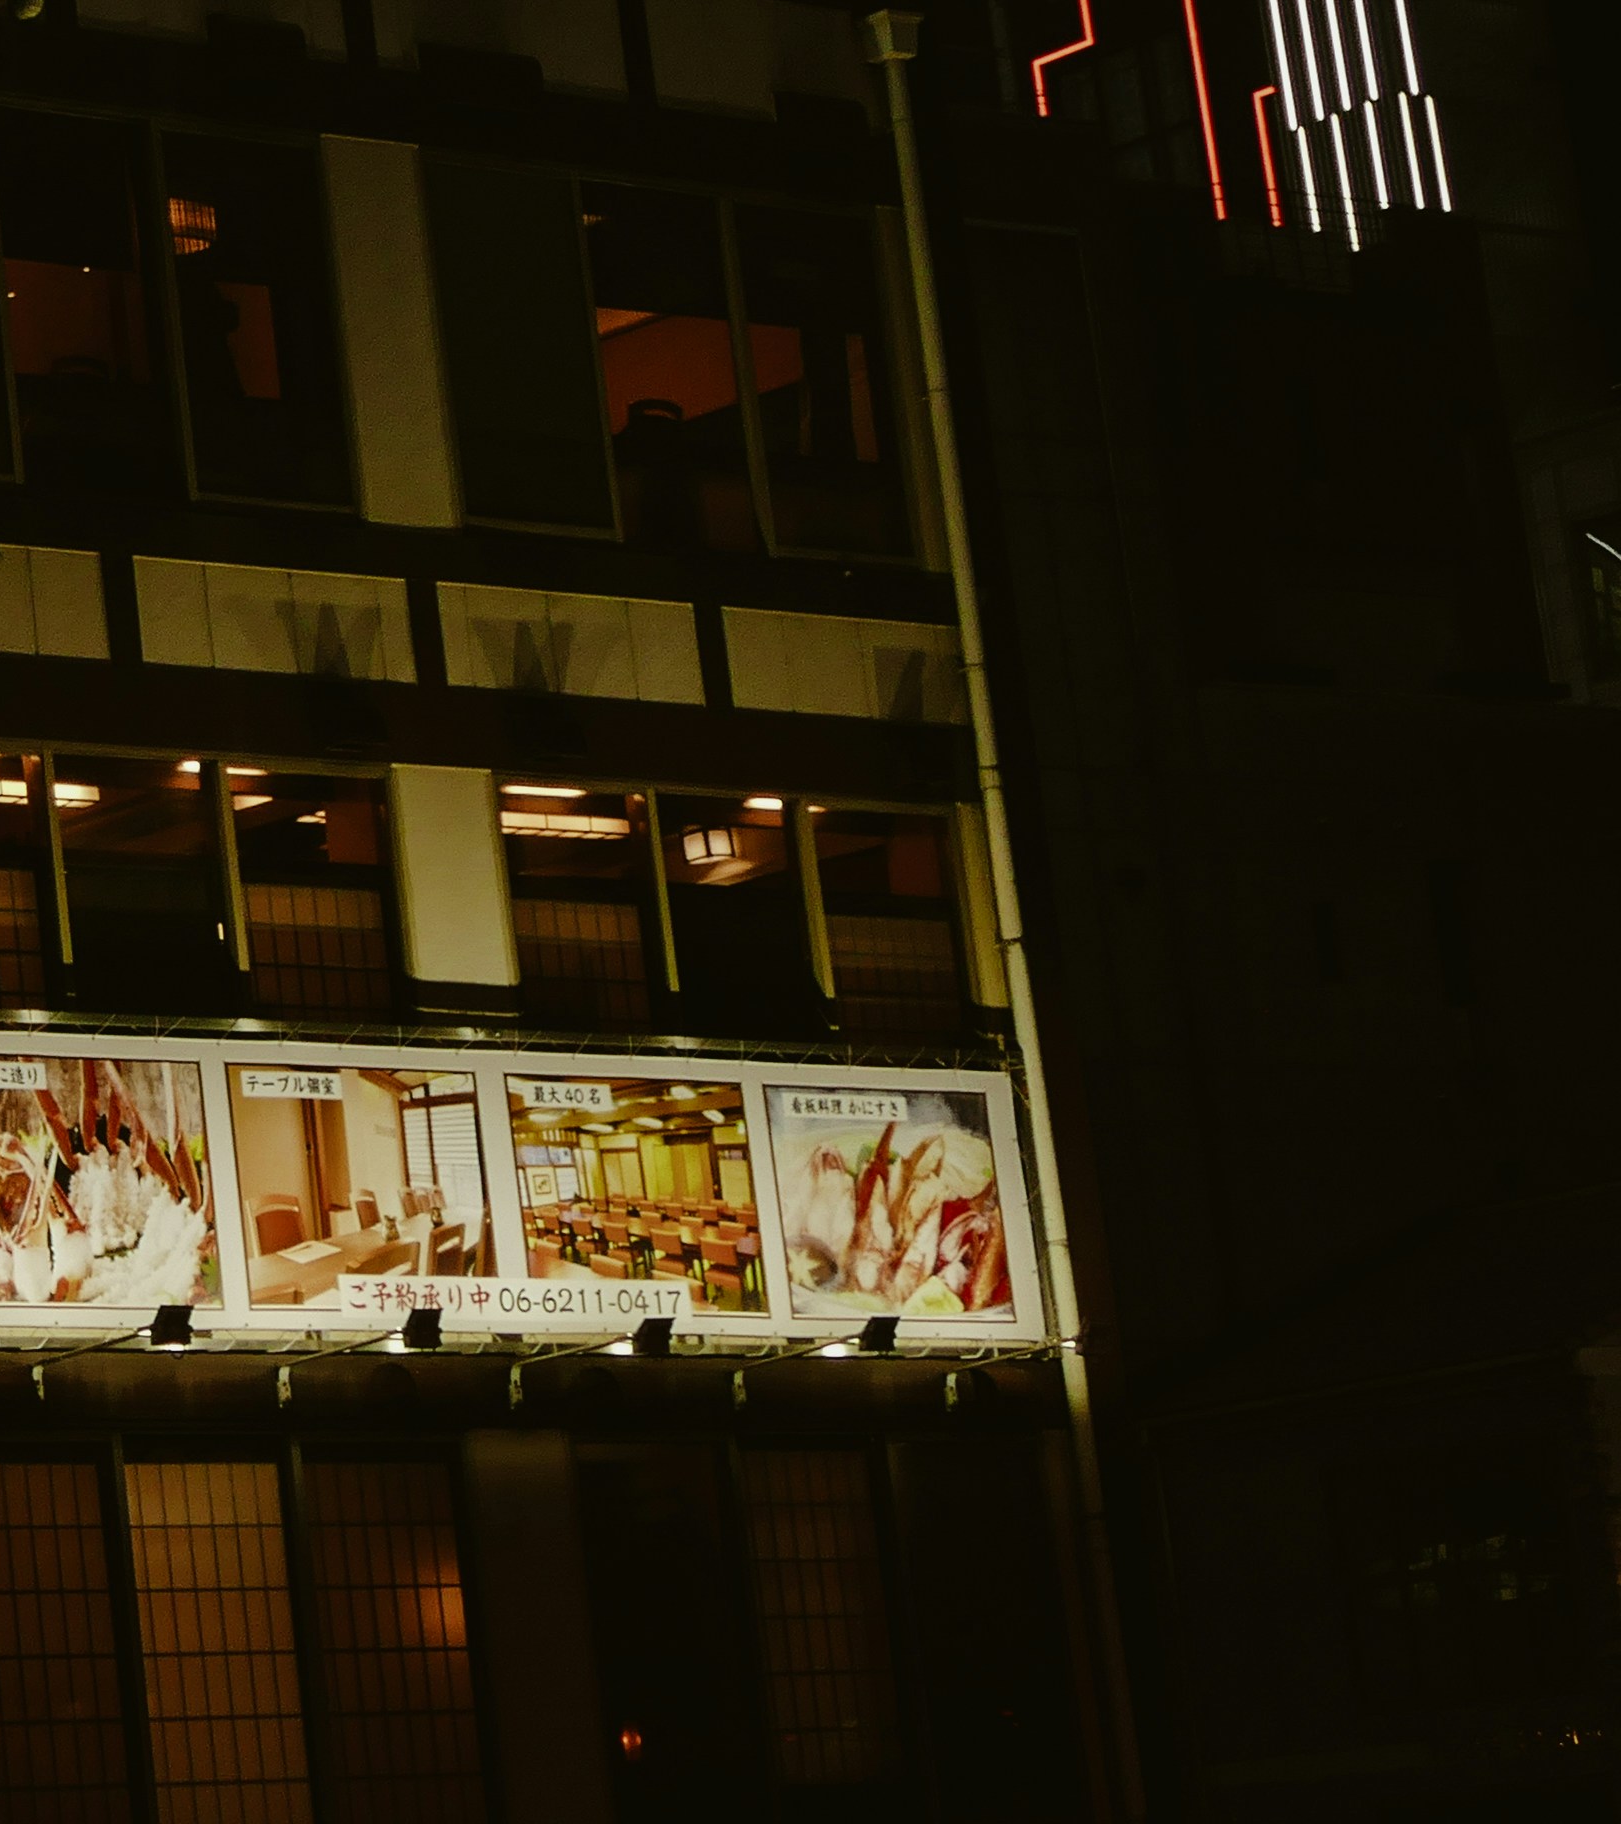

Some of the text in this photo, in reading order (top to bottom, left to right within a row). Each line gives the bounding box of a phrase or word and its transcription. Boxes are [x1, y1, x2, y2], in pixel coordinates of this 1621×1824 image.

[348, 1282, 682, 1316] ご予約承り中 06-6211-0417
